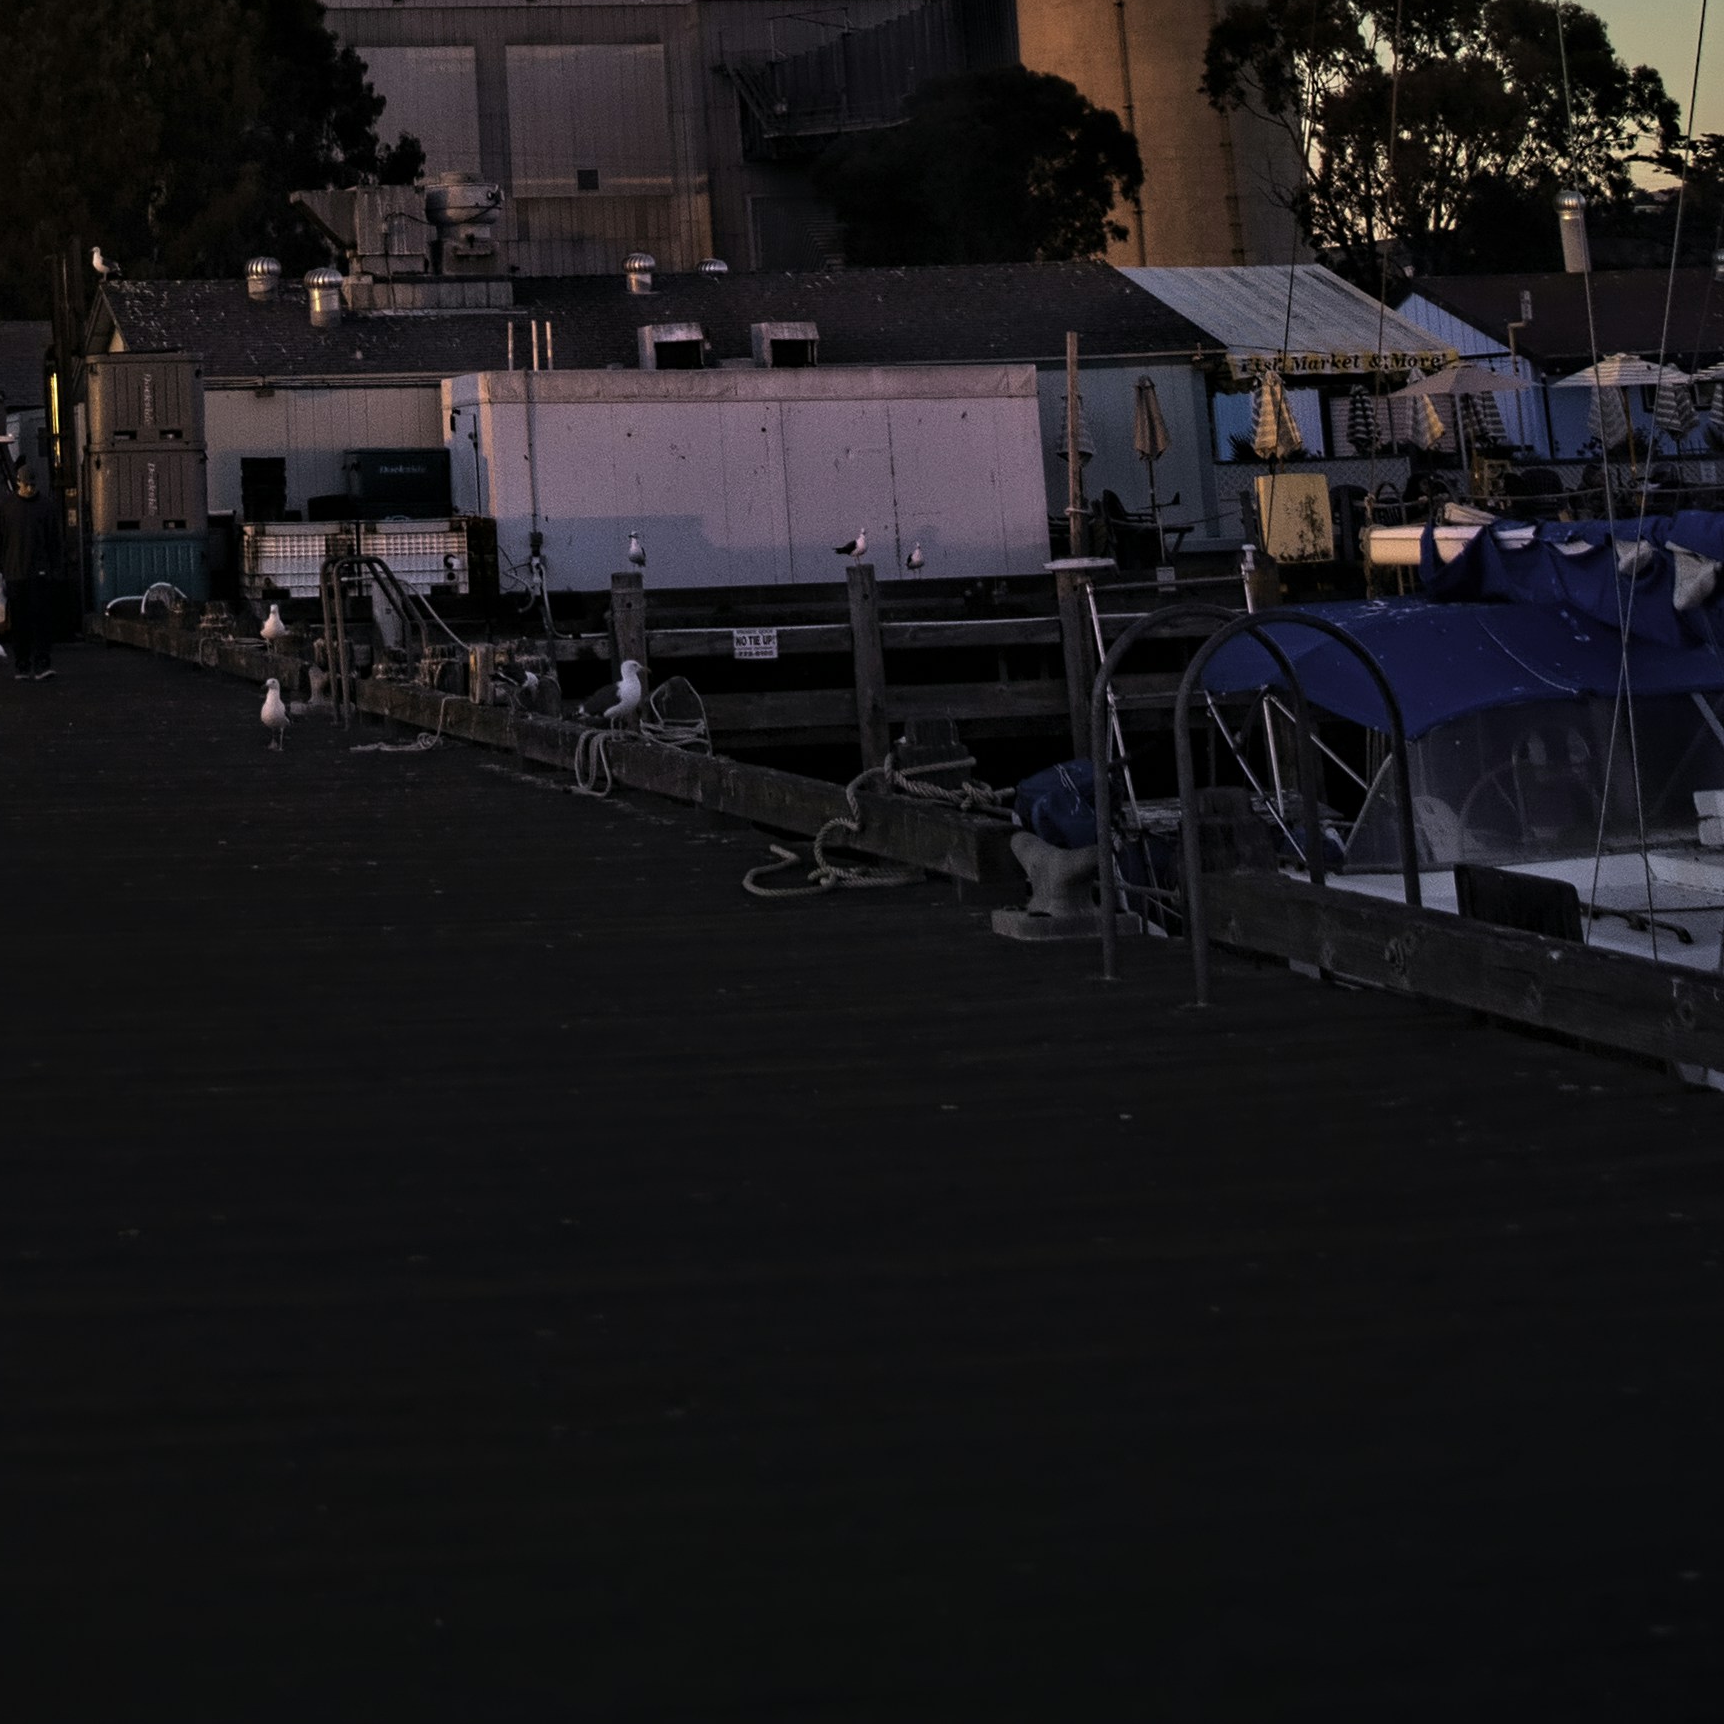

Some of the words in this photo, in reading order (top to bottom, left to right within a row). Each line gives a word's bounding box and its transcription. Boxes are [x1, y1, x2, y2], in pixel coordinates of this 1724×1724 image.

[1292, 353, 1361, 371] Market
[1369, 353, 1381, 369] &
[736, 635, 747, 647] NO
[749, 635, 761, 646] TIE
